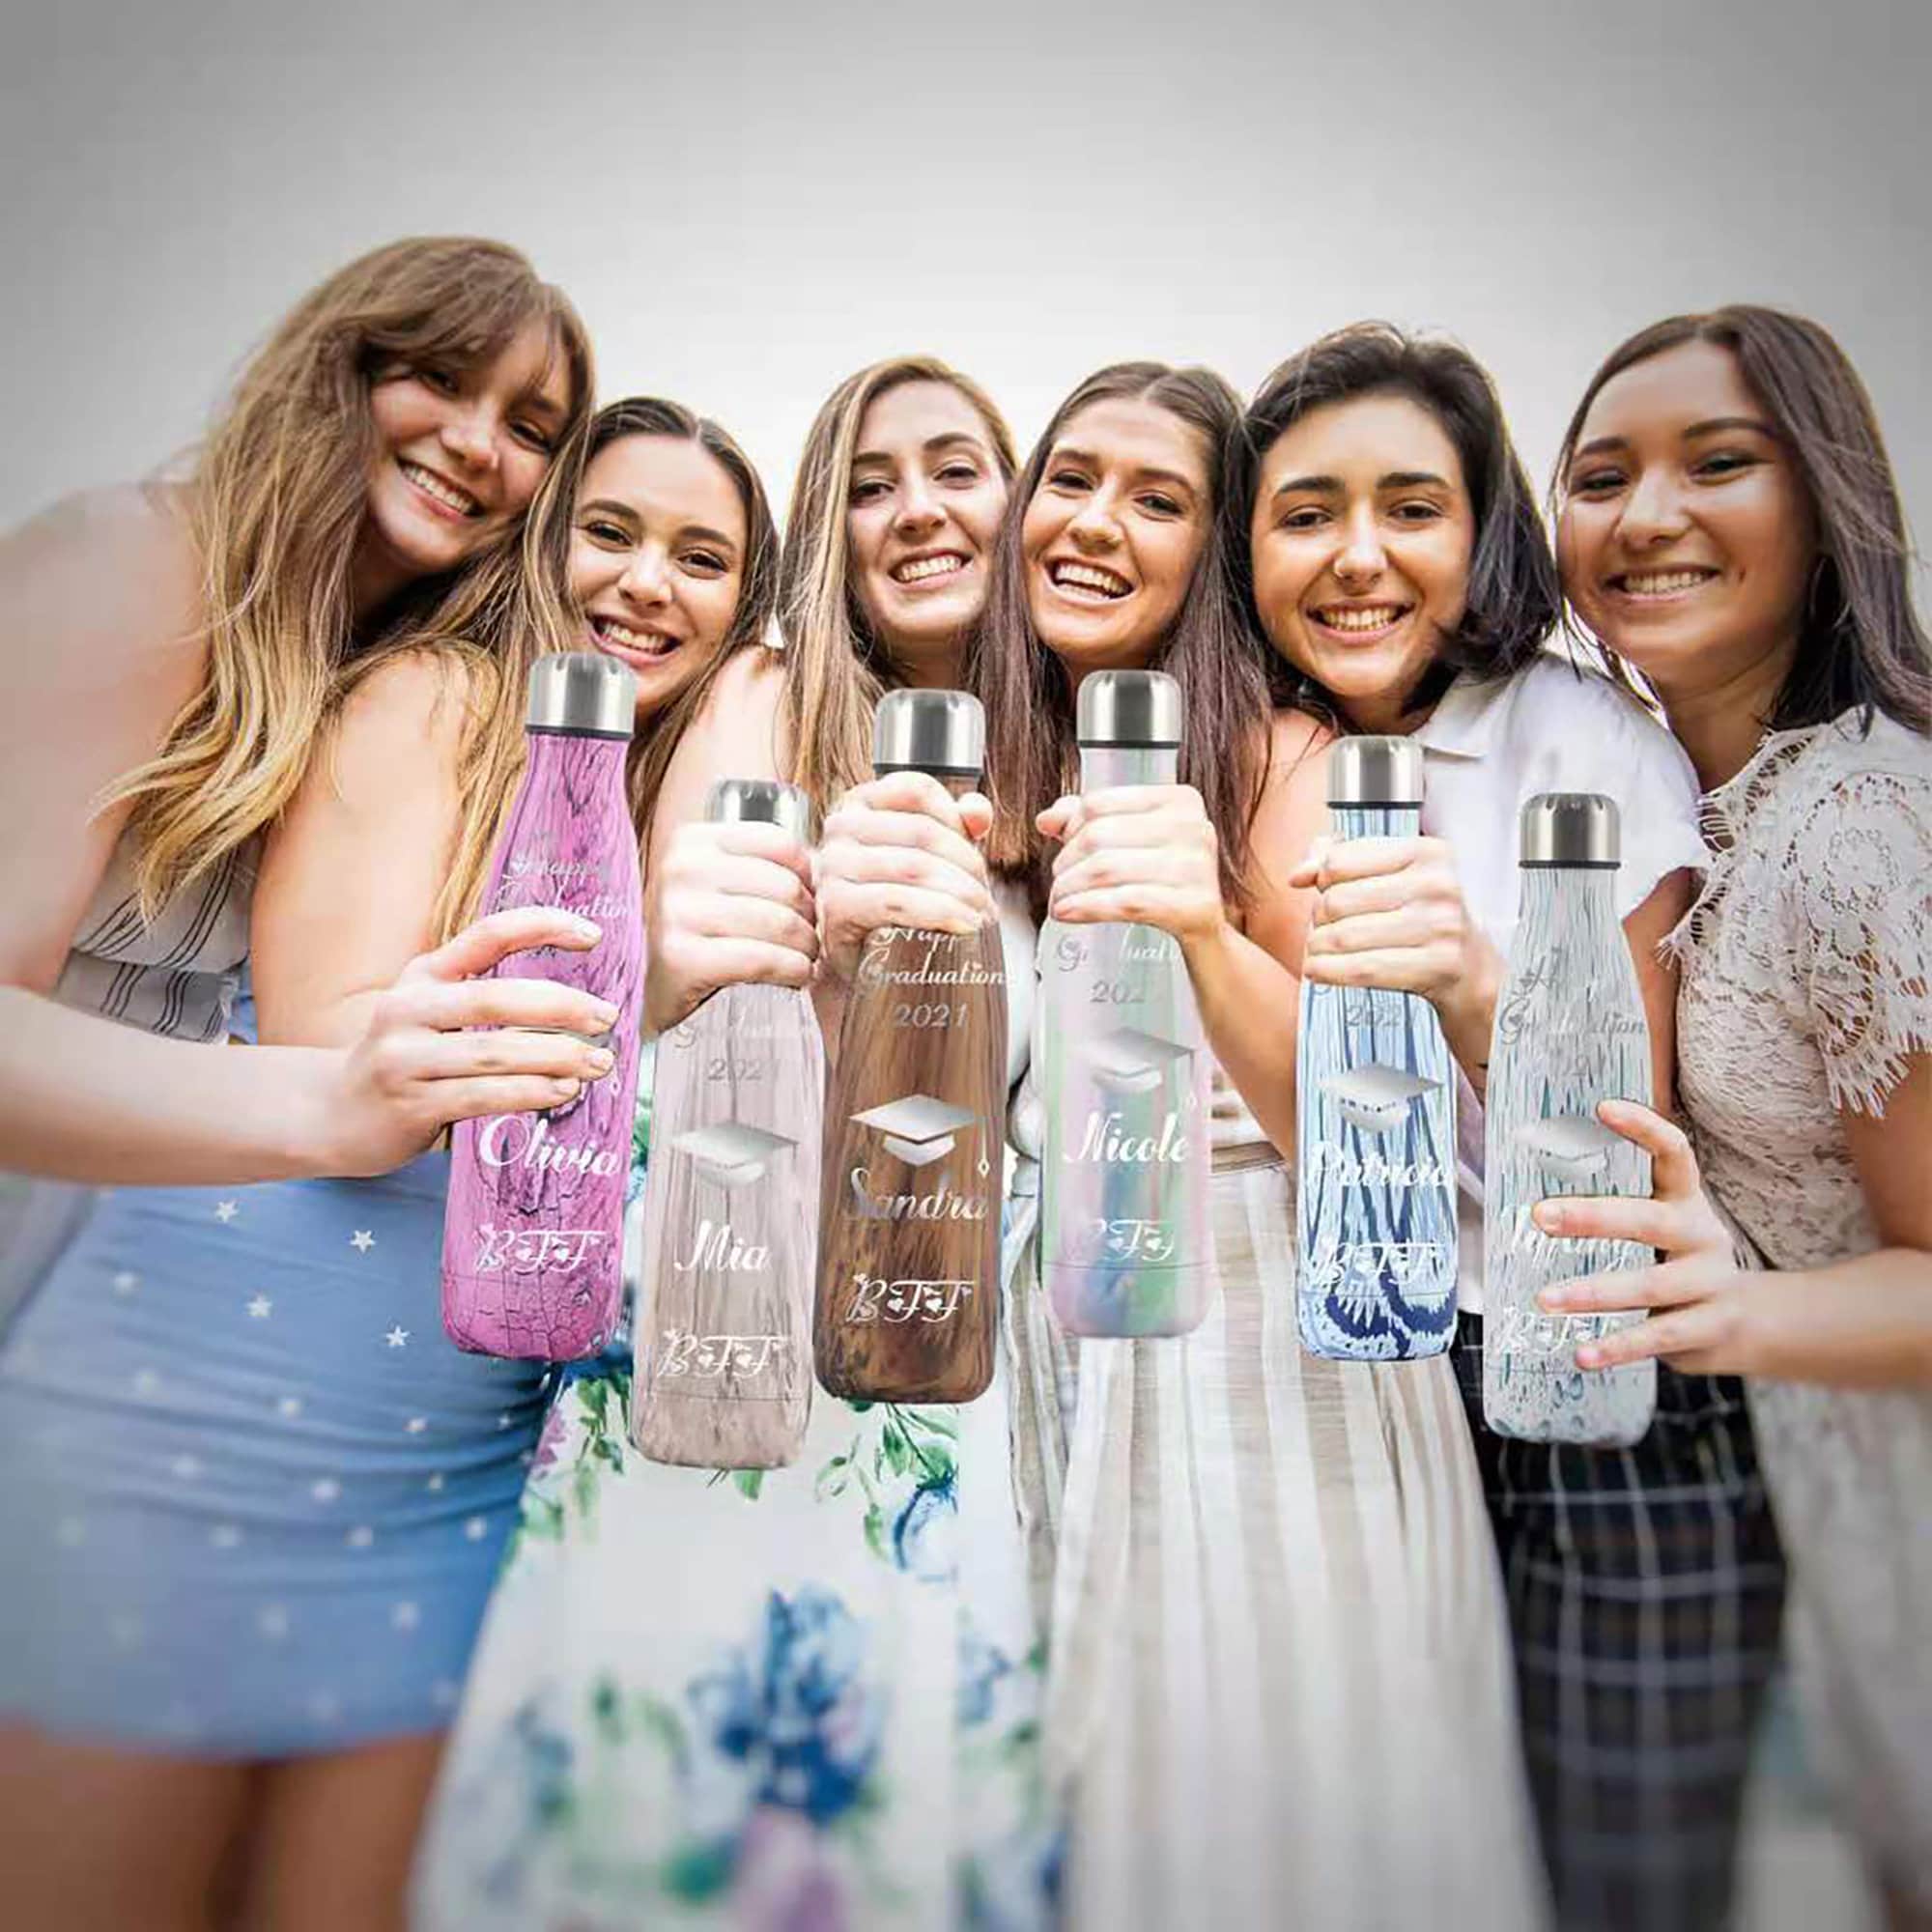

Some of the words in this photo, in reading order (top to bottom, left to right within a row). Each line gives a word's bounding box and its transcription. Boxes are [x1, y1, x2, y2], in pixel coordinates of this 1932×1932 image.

[858, 946, 1007, 999] Graduation
[893, 1003, 969, 1029] 2021
[478, 1115, 620, 1176] Olivia
[1063, 1111, 1189, 1163] Nicole
[850, 1166, 989, 1220] Sandra
[673, 1219, 775, 1272] Mia
[845, 1272, 976, 1323] BFF
[657, 1325, 788, 1378] BFF
